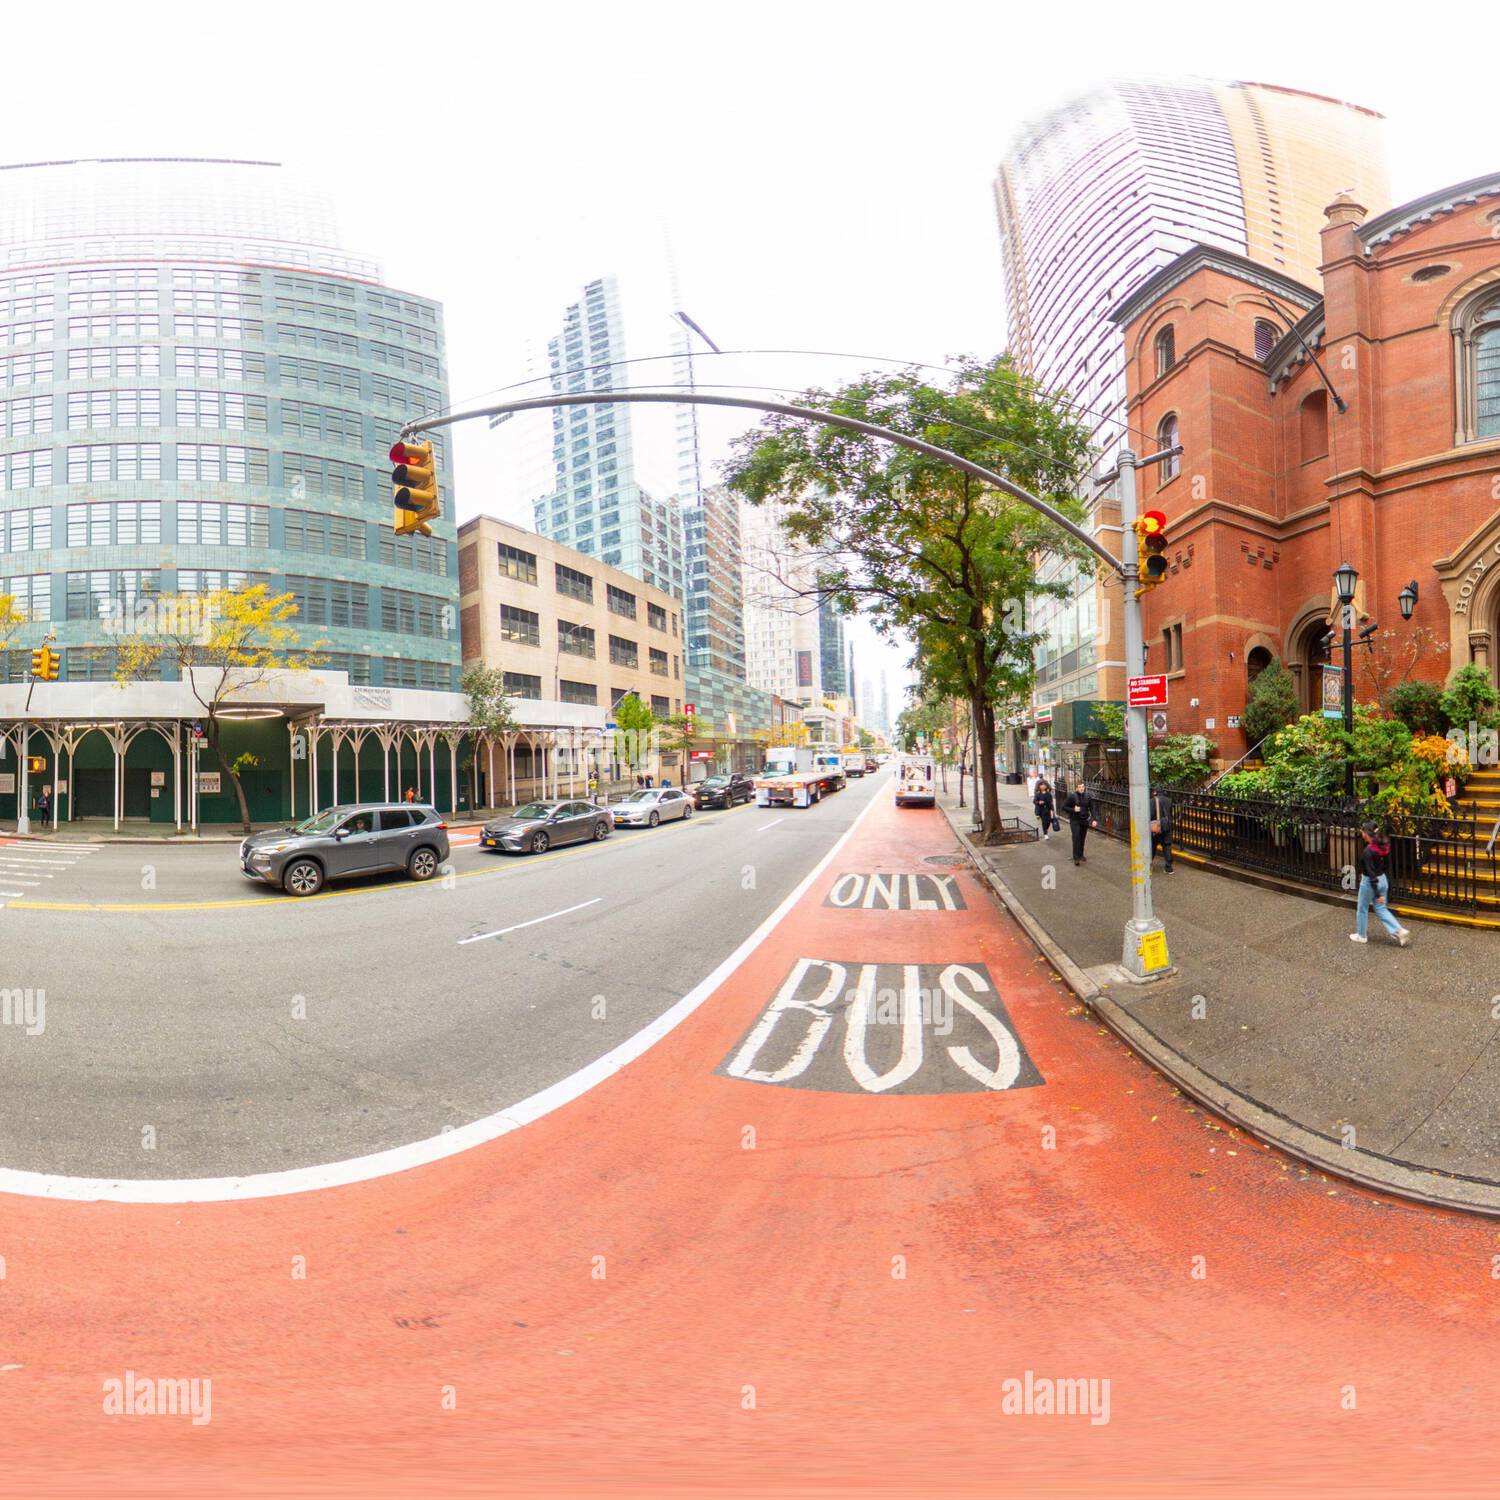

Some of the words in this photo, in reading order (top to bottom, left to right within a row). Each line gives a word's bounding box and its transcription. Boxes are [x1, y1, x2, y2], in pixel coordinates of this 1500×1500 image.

[1455, 558, 1489, 615] HOLY
[829, 874, 955, 911] ONLY
[727, 958, 1020, 1092] BUS
